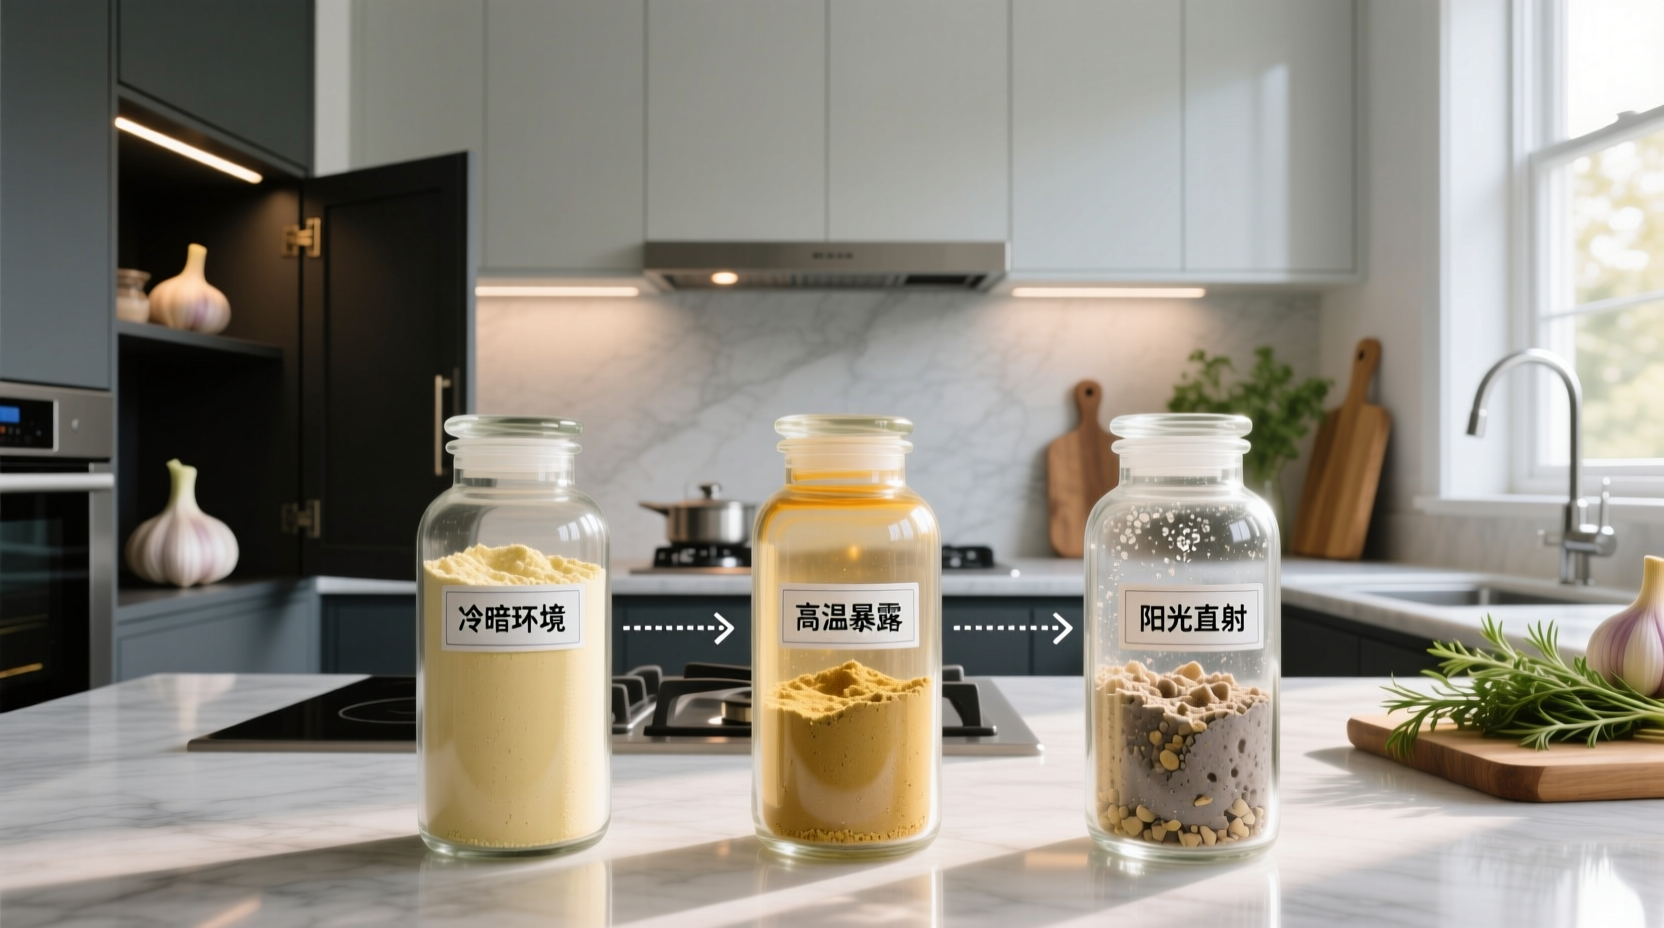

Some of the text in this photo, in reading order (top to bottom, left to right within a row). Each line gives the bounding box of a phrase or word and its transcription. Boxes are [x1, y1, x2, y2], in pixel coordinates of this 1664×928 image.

[458, 603, 566, 634] 冷暗环境
[795, 601, 903, 633] 高温暴露
[1140, 603, 1248, 633] 阳光直射
